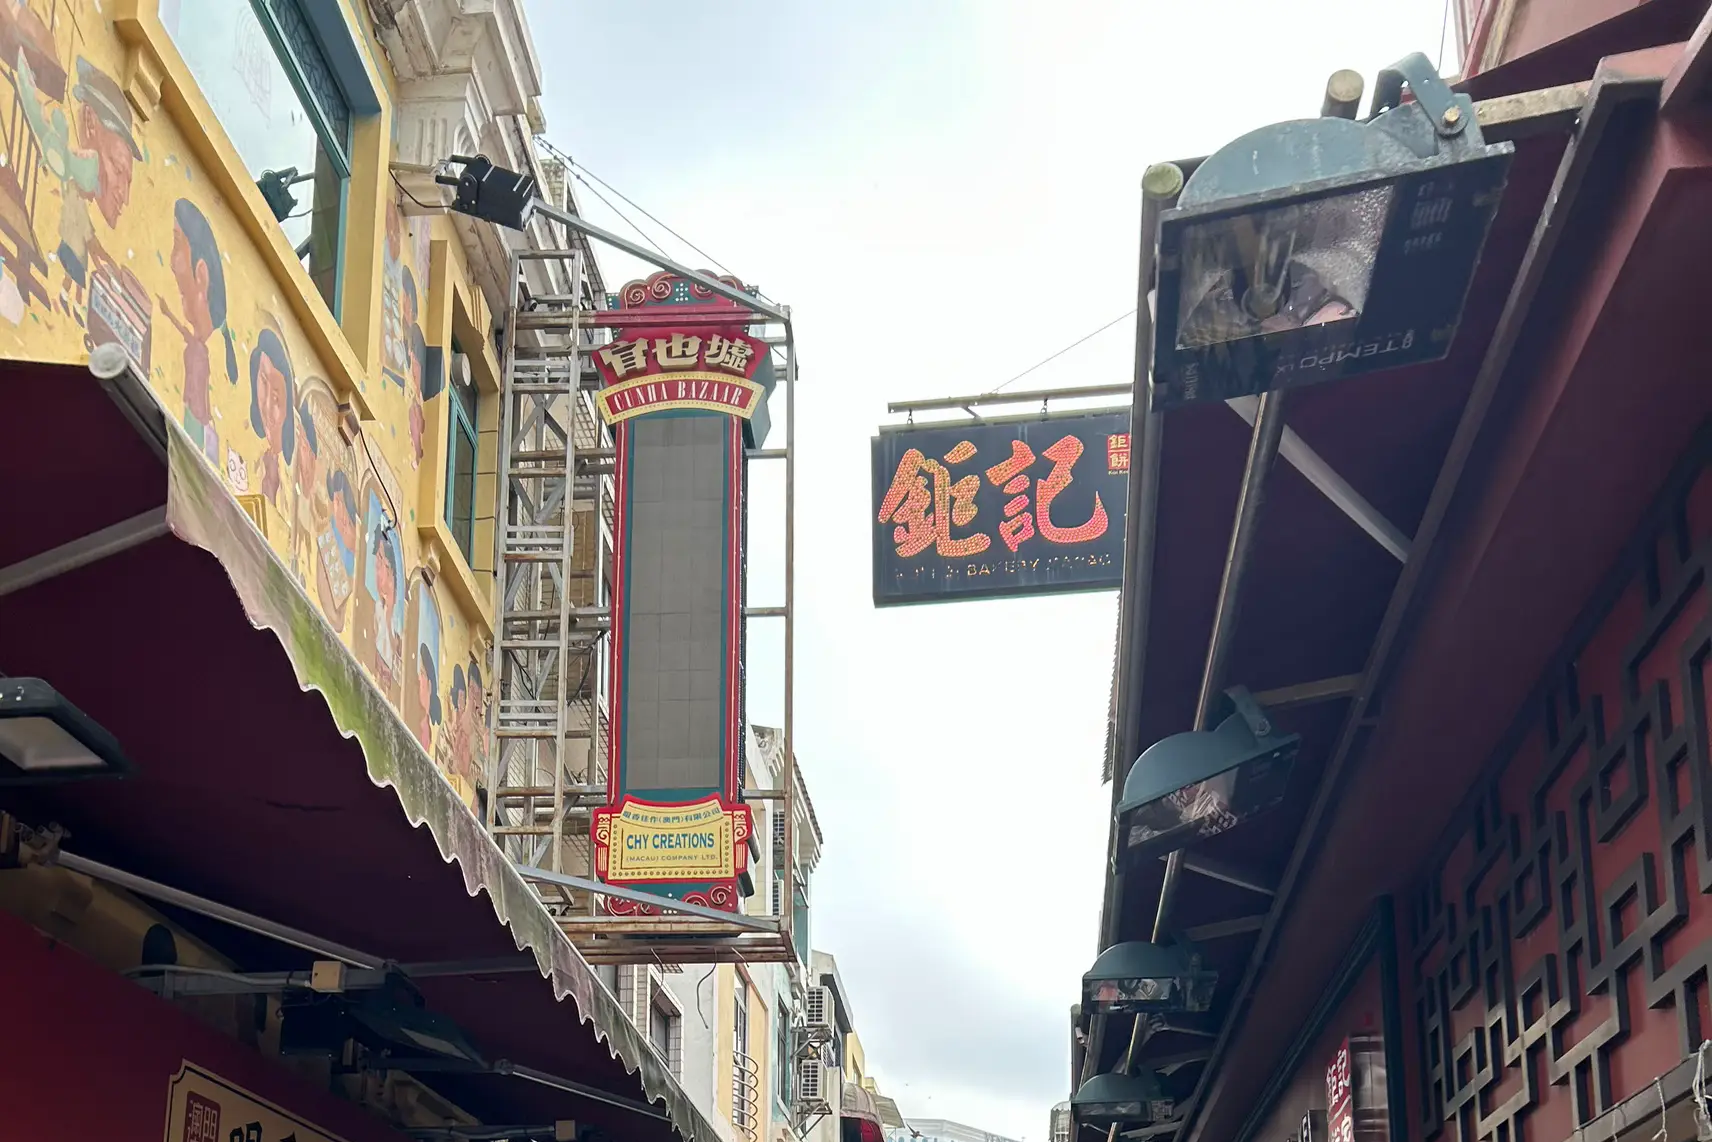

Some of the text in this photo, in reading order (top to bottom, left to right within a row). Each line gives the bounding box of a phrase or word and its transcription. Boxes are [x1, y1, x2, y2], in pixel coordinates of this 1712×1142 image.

[614, 380, 744, 412] CUNHA BAZAAR
[626, 832, 715, 850] CHY CREATIONS
[626, 855, 659, 863] (MACAU)
